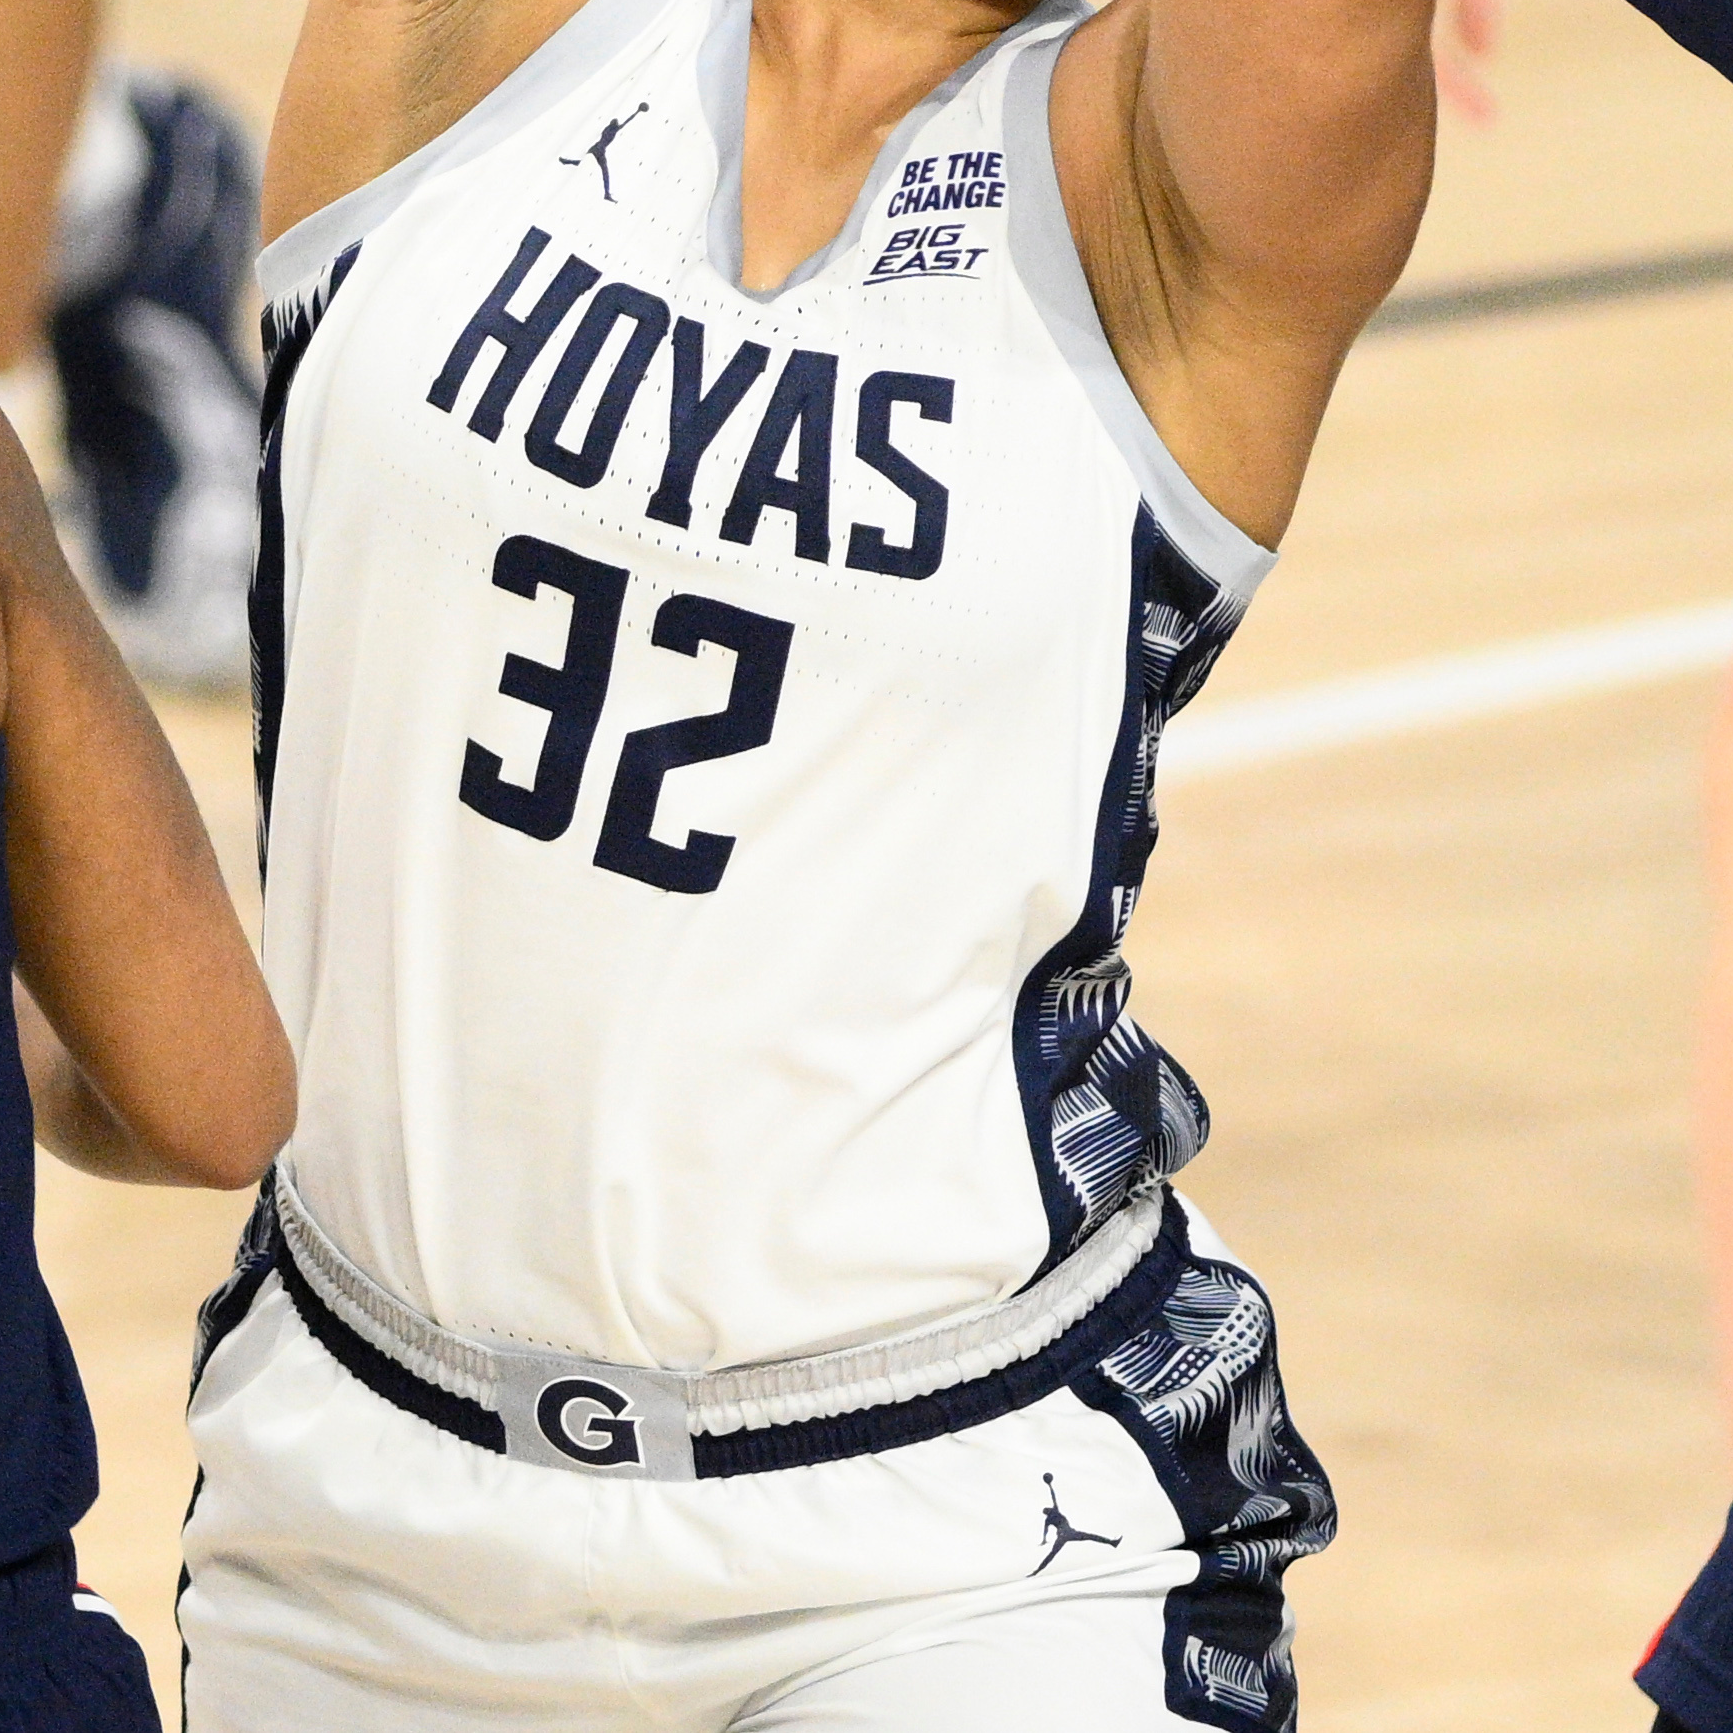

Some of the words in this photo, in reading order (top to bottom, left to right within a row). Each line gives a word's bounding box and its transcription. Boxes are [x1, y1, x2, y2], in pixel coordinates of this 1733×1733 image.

[901, 156, 939, 188] BE
[947, 151, 1003, 180] THE
[887, 180, 1005, 218] CHANGE
[883, 224, 966, 253] BIG
[869, 248, 989, 275] EAST
[425, 225, 956, 582] HOYAS
[459, 534, 795, 894] 32
[533, 1374, 645, 1471] G
